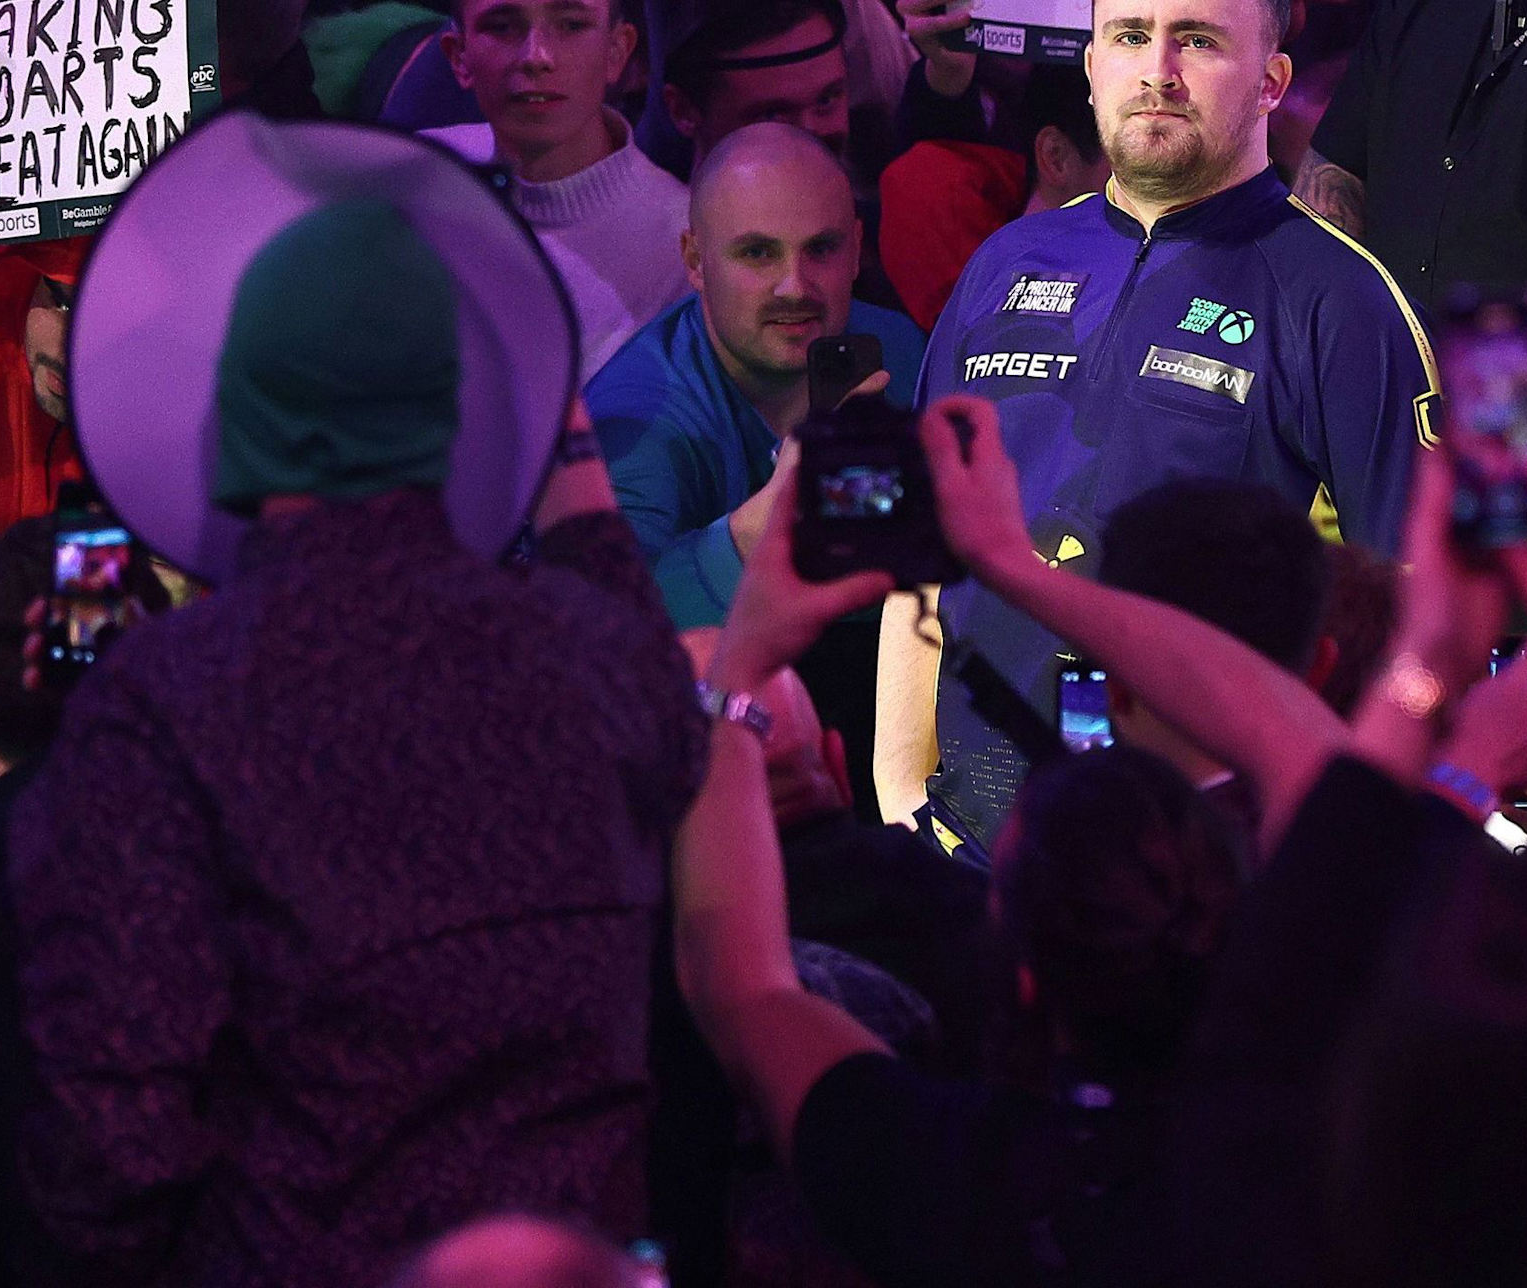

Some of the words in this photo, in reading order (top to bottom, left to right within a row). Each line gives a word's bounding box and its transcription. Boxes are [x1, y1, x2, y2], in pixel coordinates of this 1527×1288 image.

[985, 28, 1023, 49] sports
[61, 204, 113, 220] BeGamble
[1024, 281, 1079, 298] PROSTATE
[1016, 295, 1059, 312] CANCER
[1056, 297, 1077, 313] UK
[1190, 297, 1228, 314] SCORE
[1184, 314, 1216, 327] WITH
[1188, 306, 1223, 321] MORE
[1176, 320, 1207, 334] XBOX
[964, 352, 1078, 381] TARGET
[1150, 355, 1246, 393] boohooMAN
